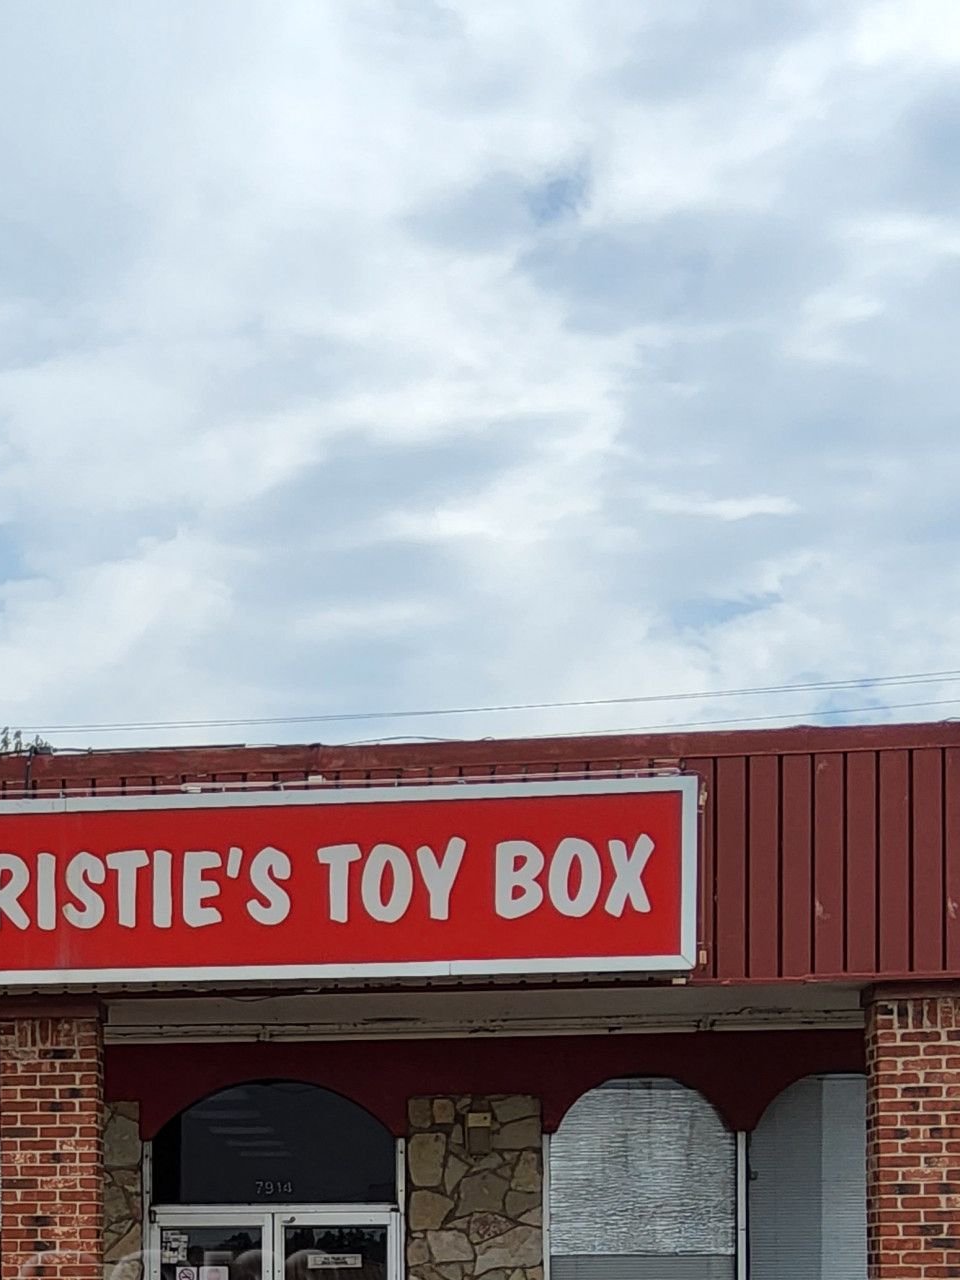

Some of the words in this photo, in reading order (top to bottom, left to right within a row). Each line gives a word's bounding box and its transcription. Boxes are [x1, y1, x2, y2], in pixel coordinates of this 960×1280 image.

[316, 836, 467, 924] TOY
[494, 833, 655, 920] BOX
[255, 1181, 293, 1195] 7914
